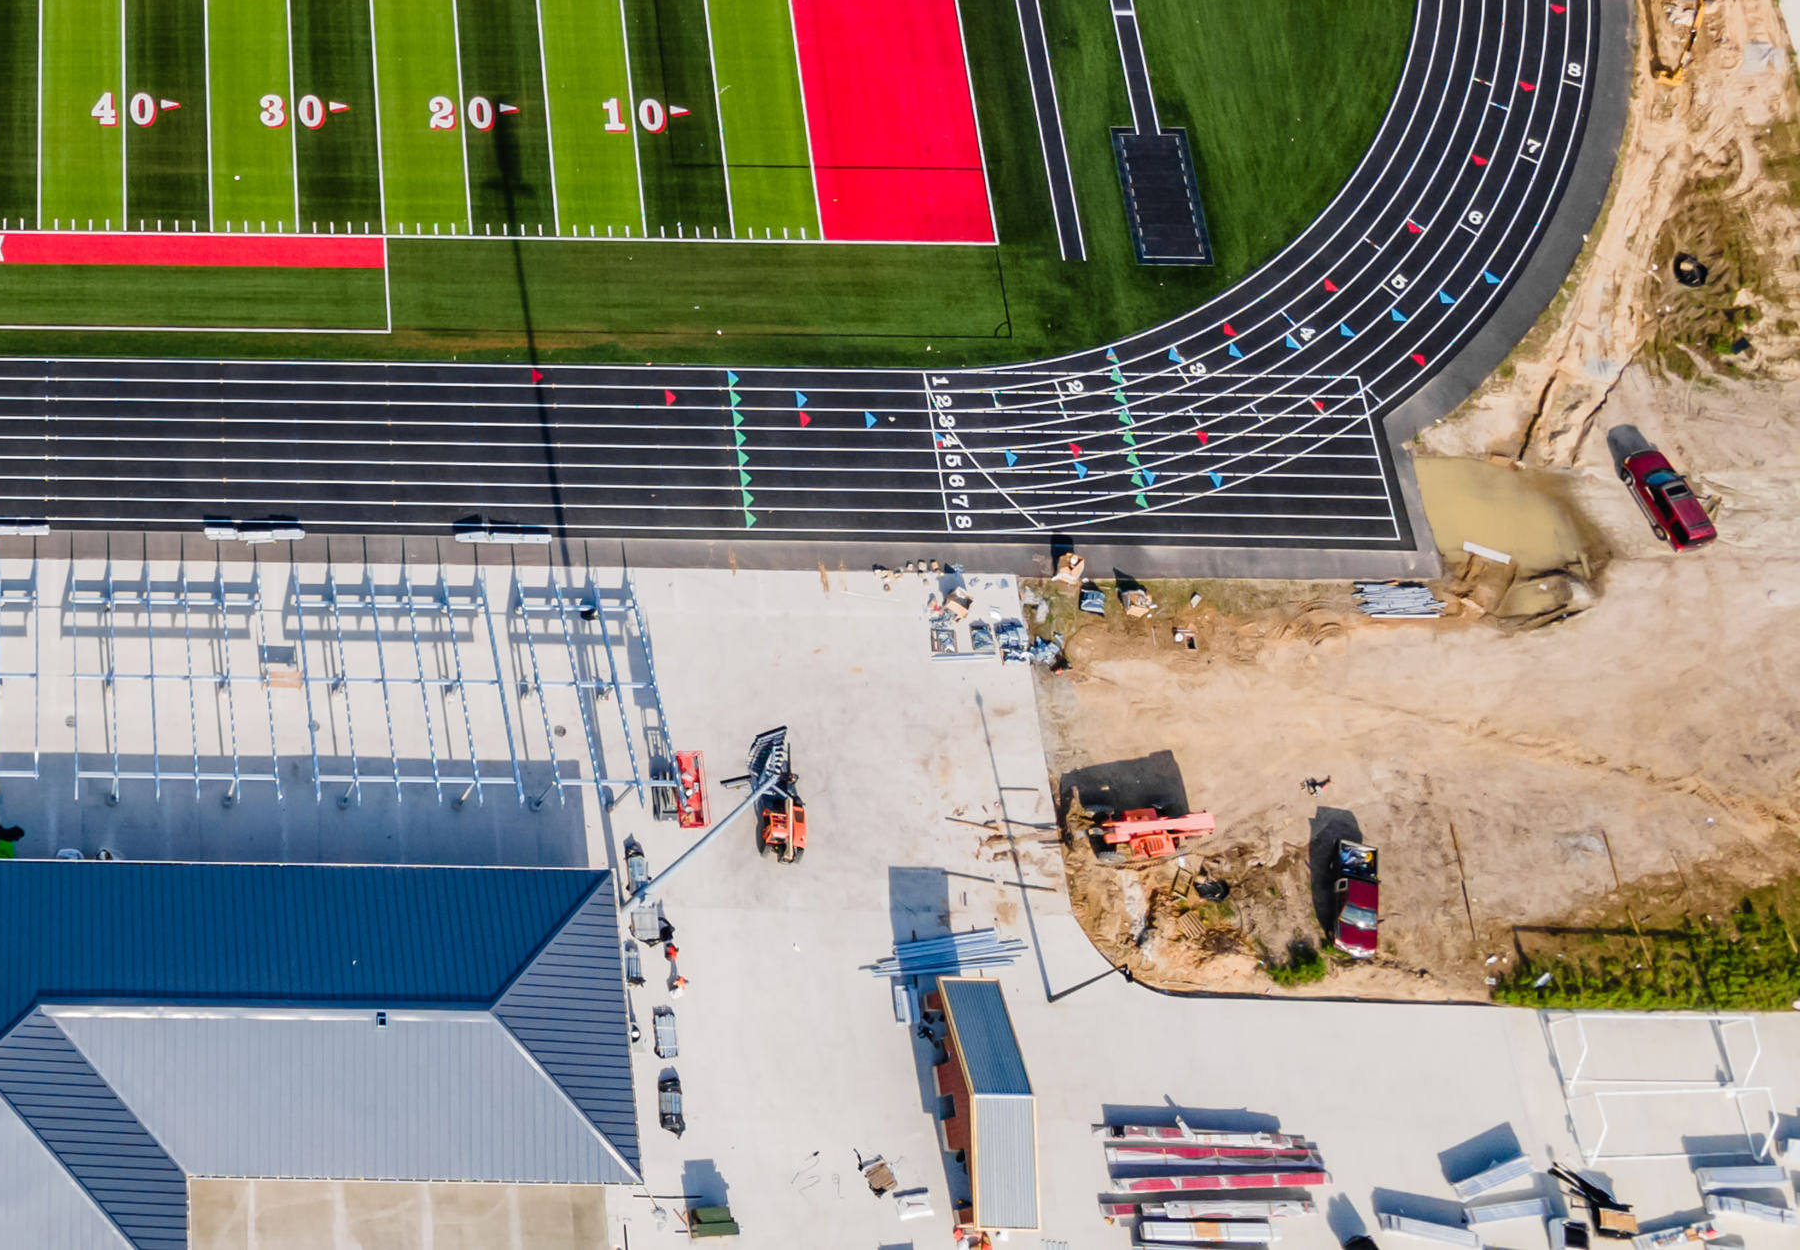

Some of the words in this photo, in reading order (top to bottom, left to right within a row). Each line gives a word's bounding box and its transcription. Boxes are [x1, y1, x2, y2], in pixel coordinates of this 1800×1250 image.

[1568, 63, 1581, 77] 8
[90, 91, 155, 127] 40
[259, 93, 324, 128] 30
[428, 94, 494, 131] 20
[602, 96, 665, 132] 10
[1527, 139, 1541, 153] 7
[1468, 211, 1484, 225] 6
[1390, 274, 1408, 289] 5
[1300, 327, 1316, 341] 4
[1189, 362, 1207, 376] 3
[932, 376, 949, 386] 1
[1068, 380, 1084, 393] 2
[936, 395, 952, 408] 2
[939, 415, 956, 428] 3
[943, 434, 959, 447] 4
[945, 454, 962, 467] 5
[949, 474, 965, 487] 6
[952, 495, 969, 508] 7
[955, 515, 972, 528] 8
